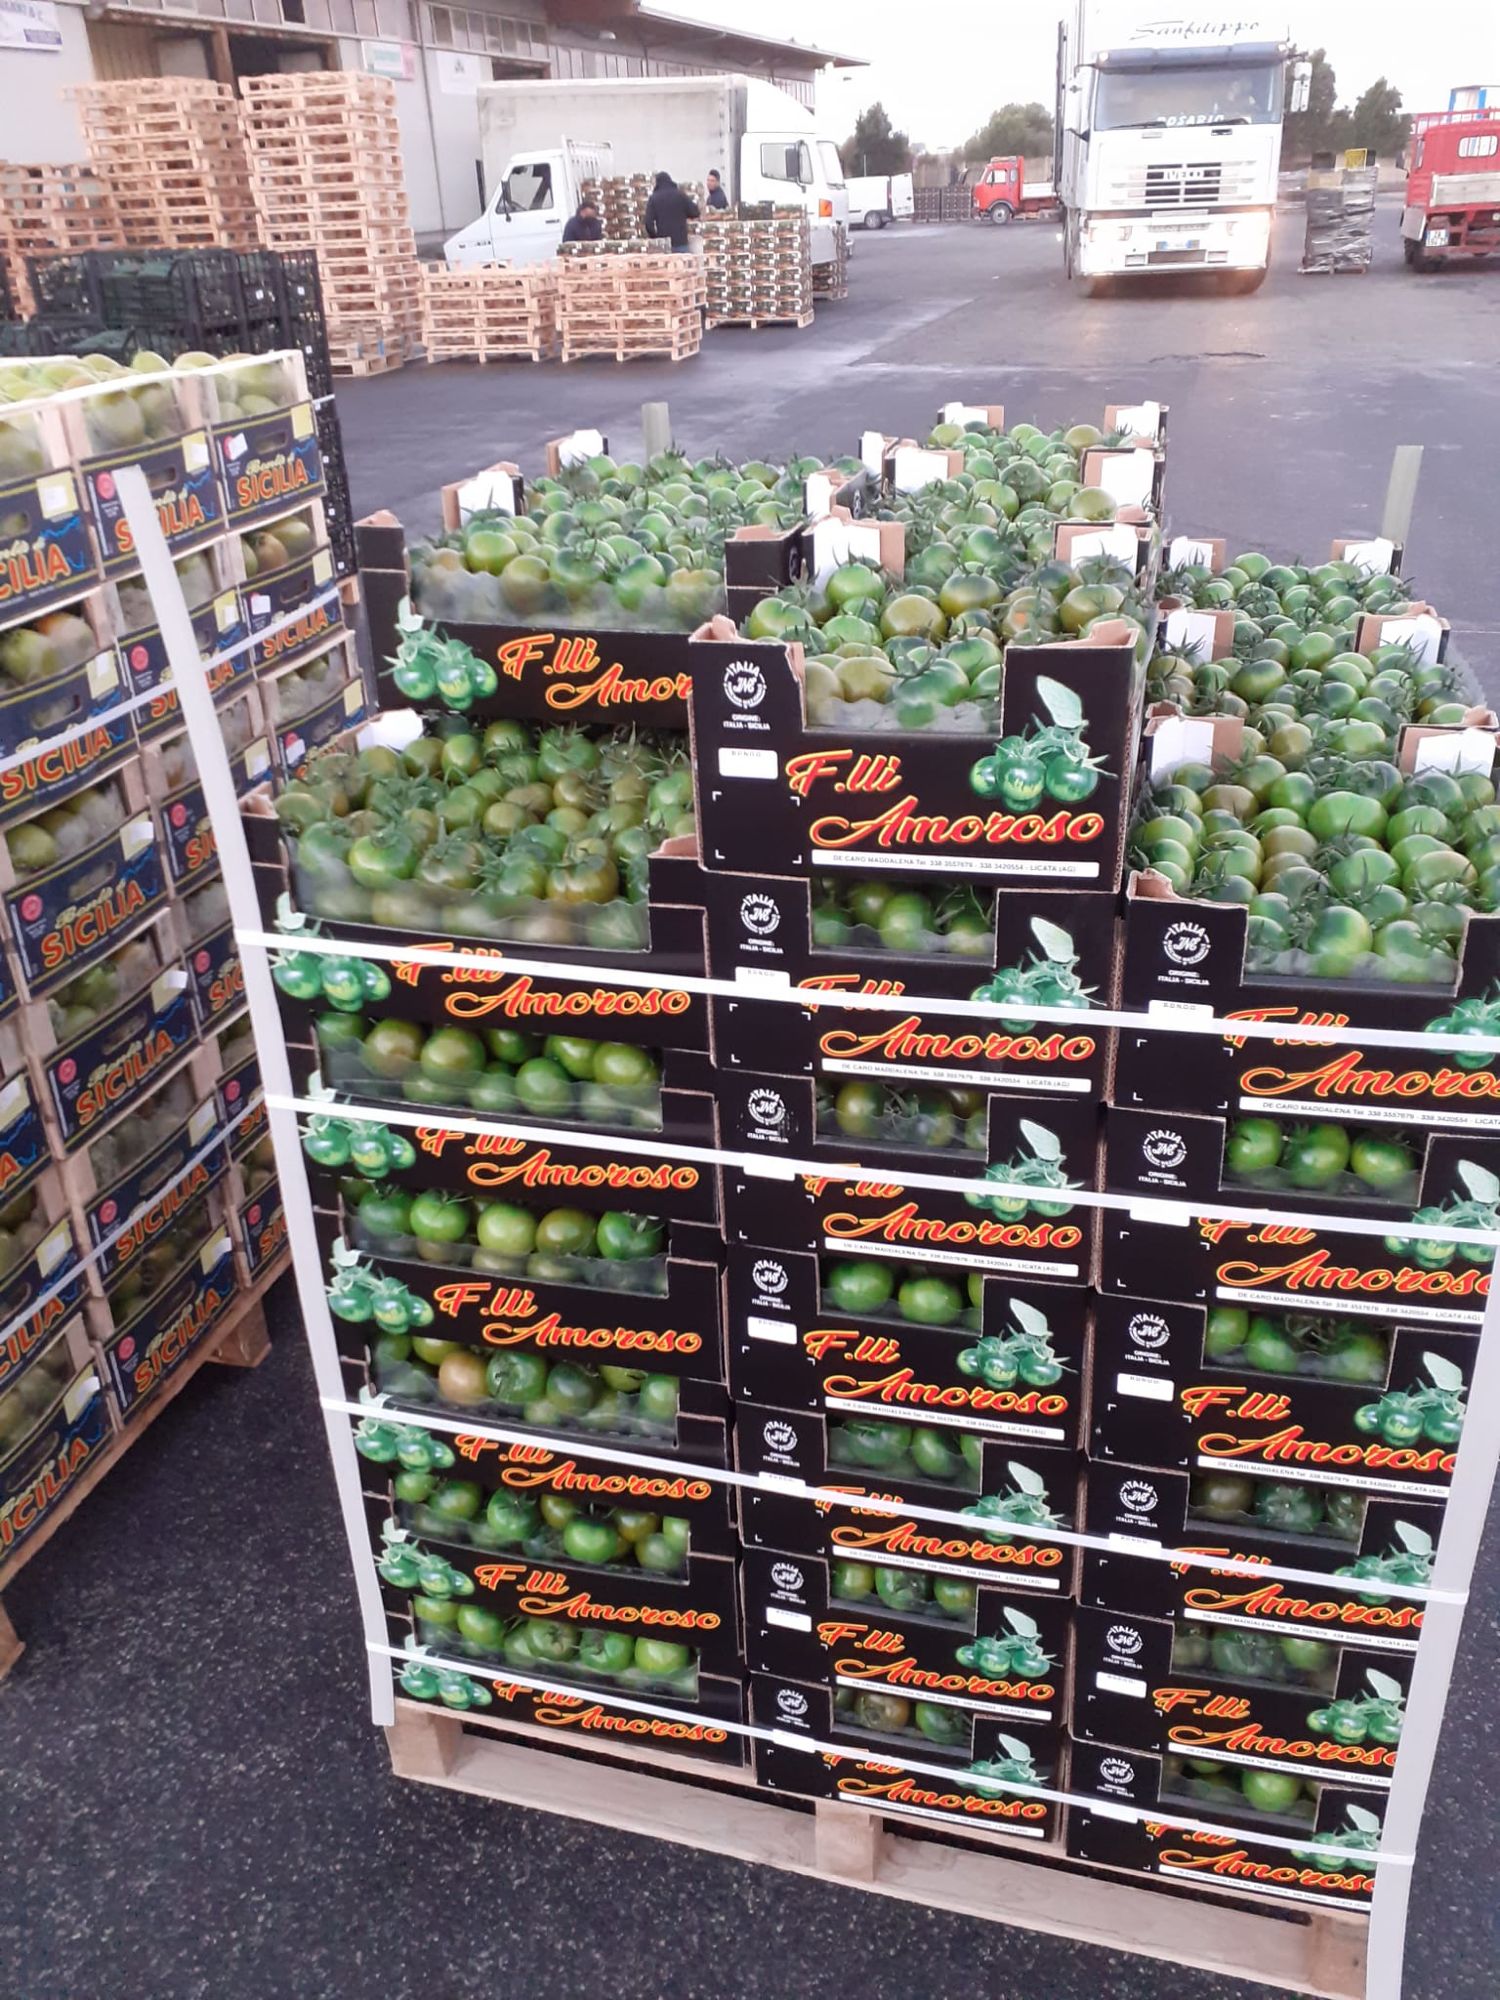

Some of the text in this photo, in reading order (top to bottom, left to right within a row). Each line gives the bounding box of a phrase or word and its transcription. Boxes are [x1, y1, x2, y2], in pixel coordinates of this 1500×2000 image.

[237, 458, 308, 507] SICILIA
[114, 494, 205, 552] SILIA
[262, 606, 328, 659] SICILIA
[495, 632, 602, 681] F.lli
[543, 662, 693, 710] Amor
[0, 725, 112, 800] SICILIA
[786, 750, 902, 797] F.lli
[810, 796, 1105, 849] Amoroso
[41, 879, 146, 968] SICILIA
[443, 975, 692, 1018] Amoroso
[818, 1014, 1097, 1063] Amoroso
[76, 1029, 174, 1126] SICILIA
[1239, 1050, 1500, 1099] Amoro
[465, 1148, 700, 1190] Amoroso
[115, 1163, 209, 1261] SICILIA
[821, 1202, 1083, 1249] Amoroso
[432, 1281, 539, 1319] F.lli
[134, 1288, 221, 1392] SICILIA
[480, 1312, 703, 1354] Amoroso
[803, 1329, 900, 1365] F.lli
[821, 1368, 1069, 1416] Amoroso
[1178, 1384, 1292, 1422] F.lli
[0, 1437, 90, 1550] ICILIA
[499, 1459, 712, 1501] Amoroso
[829, 1520, 1063, 1567] Amoroso
[473, 1563, 570, 1596] F.lli
[517, 1593, 722, 1630] Amoroso
[816, 1621, 905, 1654] F.lli
[832, 1656, 1056, 1701] Amoroso
[533, 1704, 728, 1743] Amoroso
[1151, 1687, 1251, 1720] F.lli
[835, 1776, 1049, 1820] Amoroso
